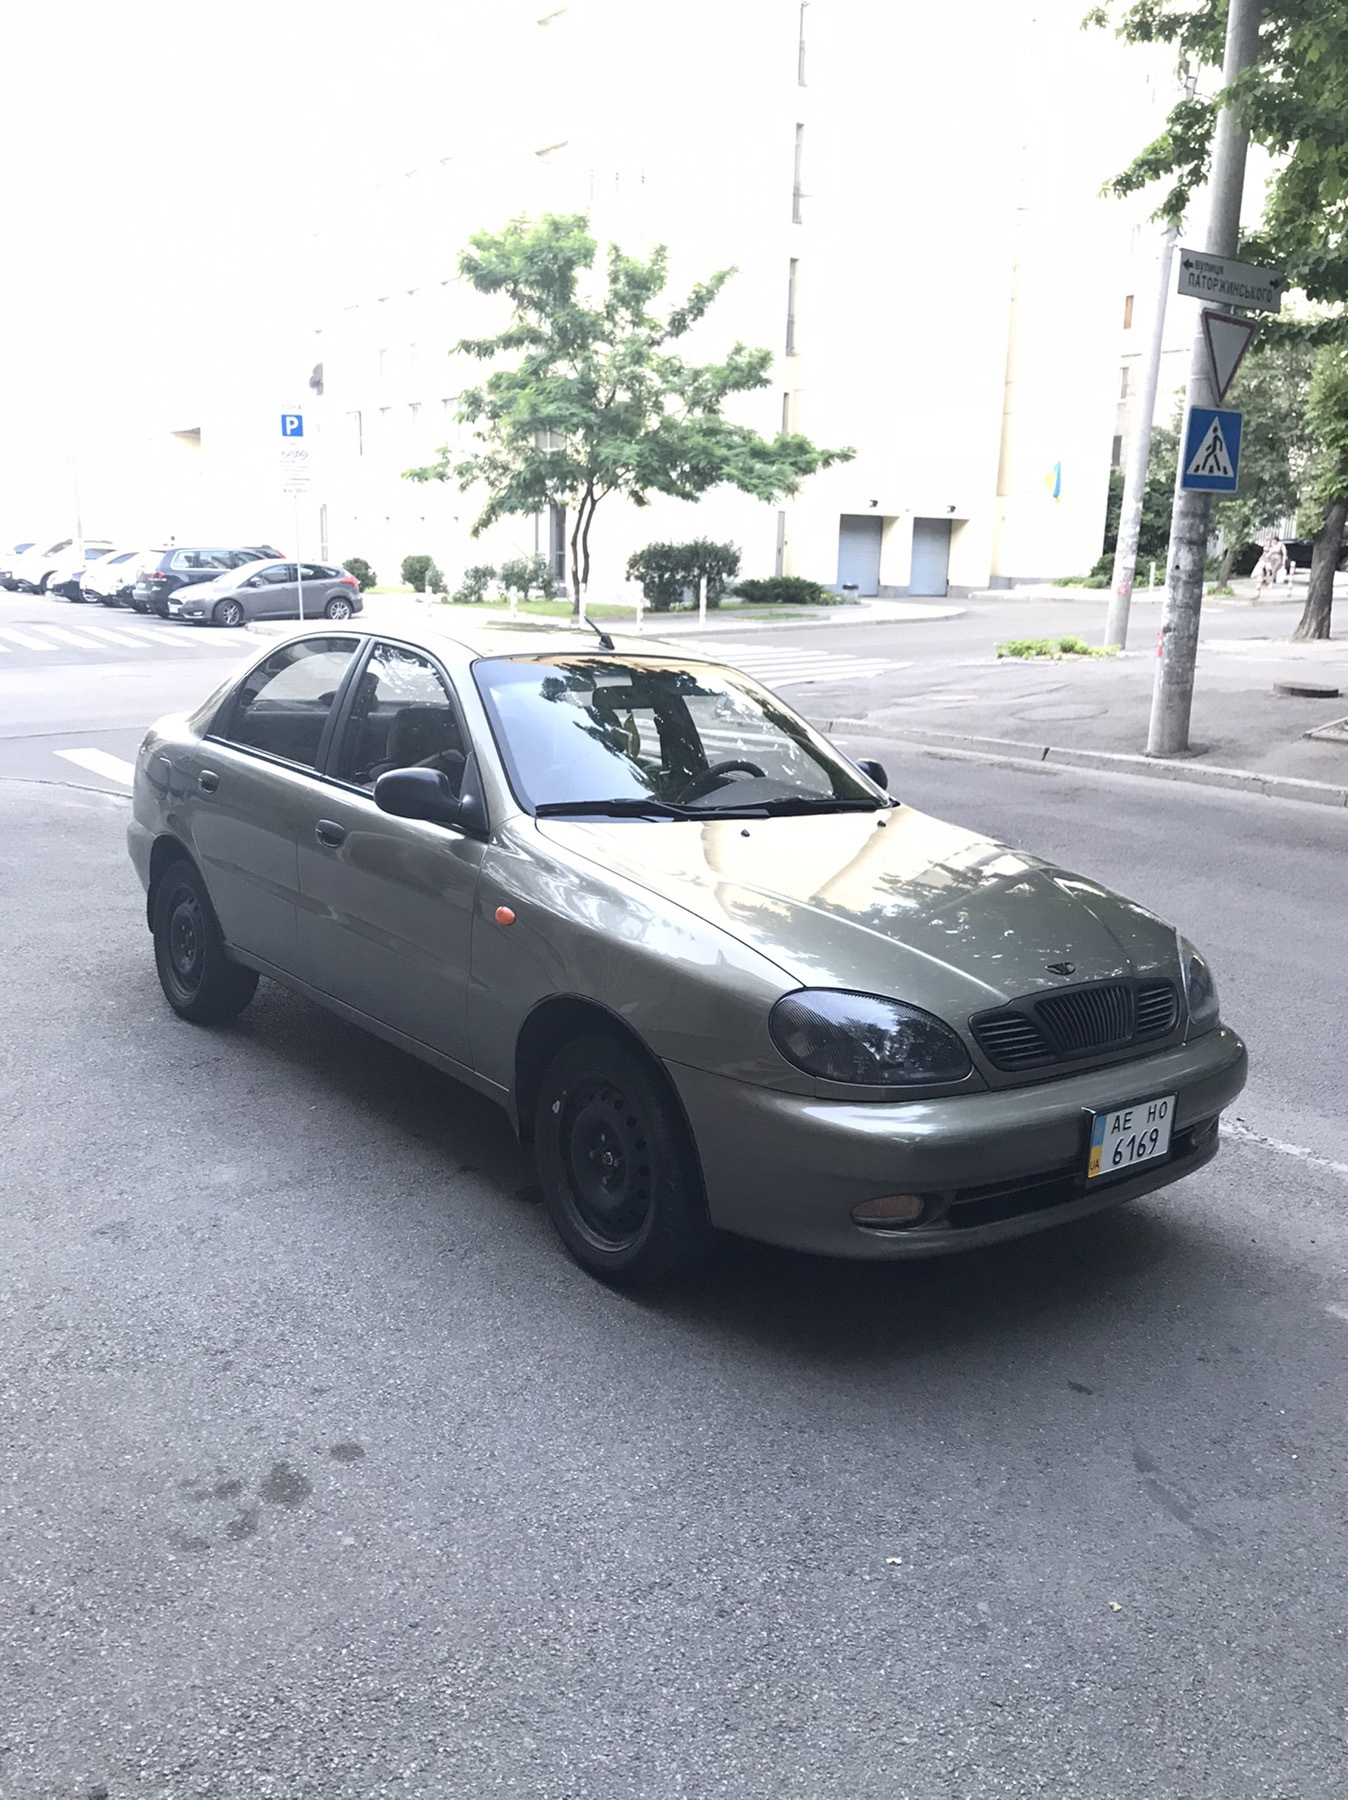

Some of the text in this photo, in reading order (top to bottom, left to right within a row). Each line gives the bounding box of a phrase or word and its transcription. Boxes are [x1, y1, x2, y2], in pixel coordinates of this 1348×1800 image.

[1188, 272, 1273, 303] ПАТОРЖИНСЬКОГО
[286, 416, 299, 436] P
[1111, 1101, 1168, 1134] AE HO
[1113, 1127, 1159, 1165] 6169
[1090, 1159, 1100, 1170] UA
